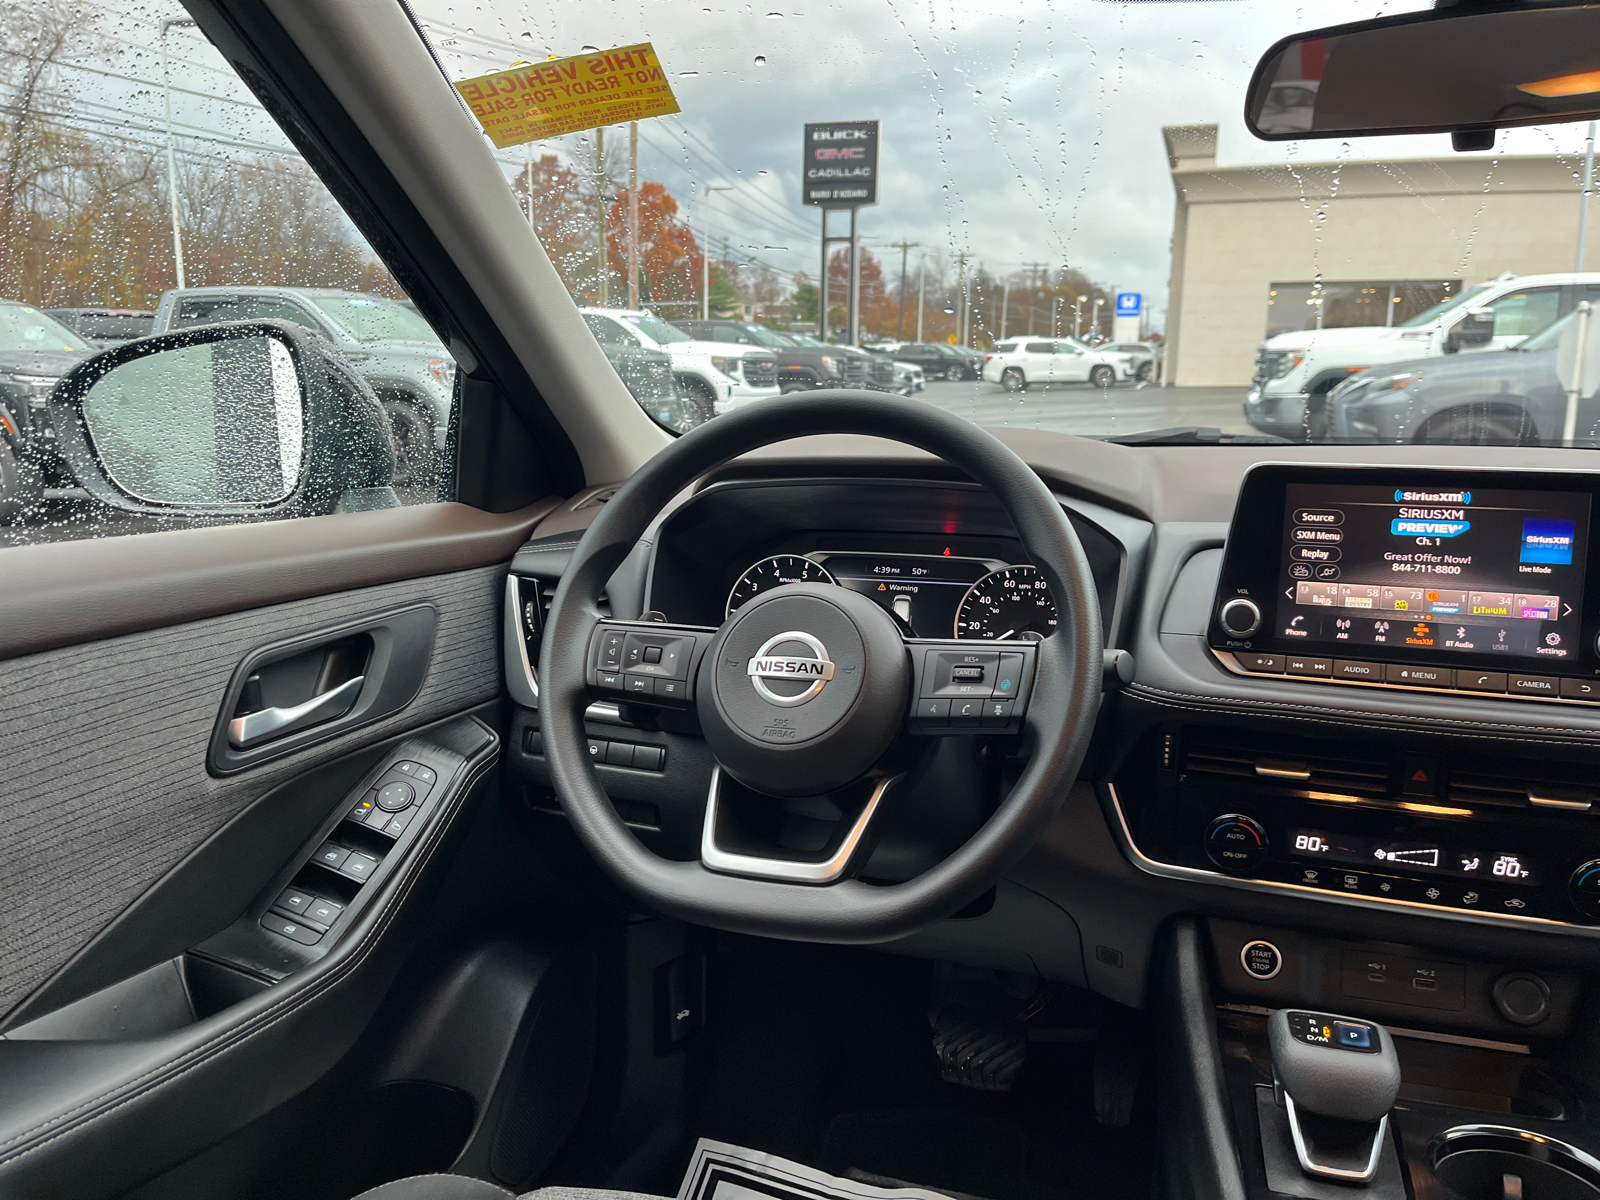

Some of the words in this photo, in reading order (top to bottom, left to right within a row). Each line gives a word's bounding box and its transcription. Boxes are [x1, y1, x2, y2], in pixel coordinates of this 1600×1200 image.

[813, 129, 869, 141] BUICK
[815, 147, 866, 160] GMC
[808, 166, 872, 178] CADILLAC
[1302, 512, 1335, 522] Source
[1398, 507, 1464, 520] SIRIUSXM
[1397, 522, 1464, 534] PREVIEW
[1296, 530, 1316, 540] SXM
[1316, 532, 1340, 540] Menu
[1526, 535, 1570, 544] SiriusXM
[1416, 536, 1432, 546] Ch.
[1435, 538, 1440, 546] 1
[1301, 548, 1330, 560] Replay
[1384, 552, 1413, 561] Great
[1414, 554, 1442, 562] Offer
[1444, 555, 1472, 564] Now!
[1392, 562, 1462, 574] 844-711-8800
[774, 569, 780, 578] 4
[802, 570, 808, 579] 5
[752, 582, 758, 592] 3
[889, 584, 919, 593] Warning
[1004, 580, 1016, 588] 60
[1034, 581, 1046, 590] 80
[1326, 586, 1338, 594] 18
[1366, 588, 1379, 597] 58
[1410, 592, 1422, 600] 73
[1460, 594, 1466, 602] 1
[1498, 597, 1512, 605] 34
[1544, 600, 1557, 608] 28
[968, 622, 980, 630] 20
[1285, 628, 1308, 636] Phone
[1406, 637, 1434, 646] SiriusXM
[1536, 646, 1567, 656] Settings
[756, 660, 824, 675] NISSAN
[1344, 666, 1370, 674] AUDIO
[1412, 672, 1436, 680] MENU
[1517, 680, 1551, 689] CAMERA
[773, 718, 788, 727] SRS
[762, 728, 796, 738] AIRBAG
[1226, 832, 1246, 840] AUTO
[1251, 950, 1272, 958] START
[1252, 962, 1270, 970] STOP
[1306, 1034, 1329, 1042] D/M
